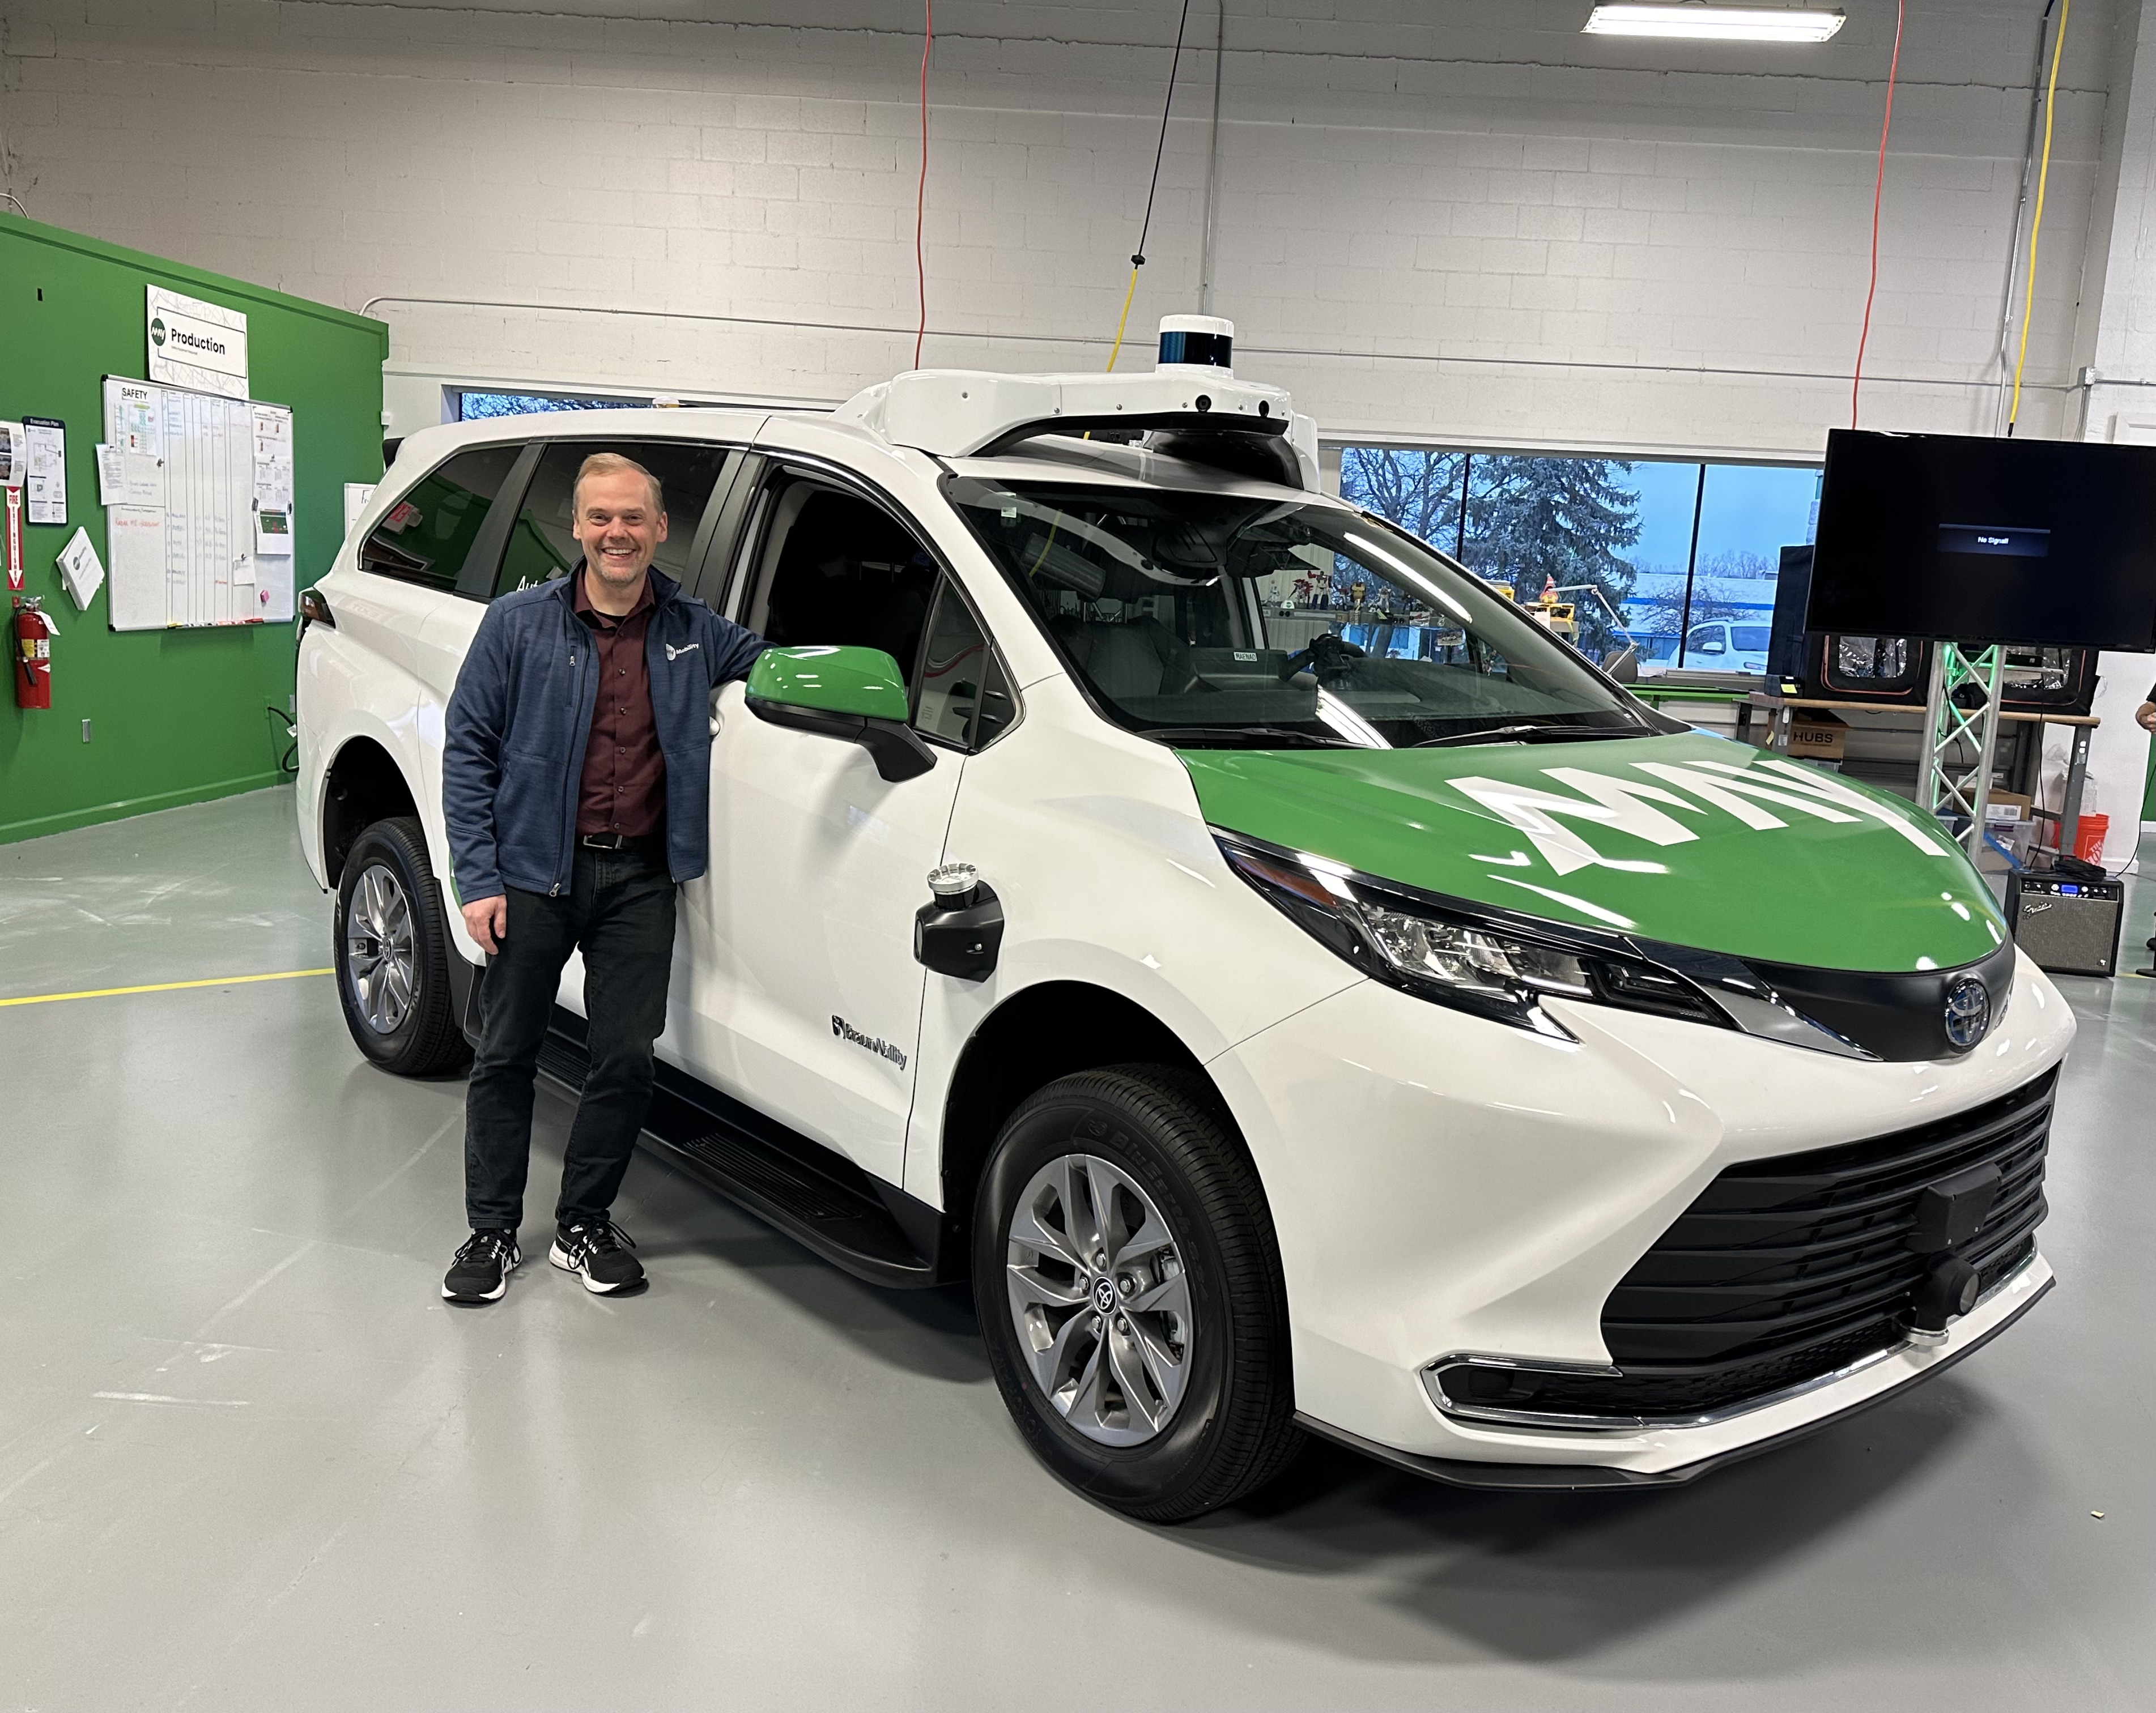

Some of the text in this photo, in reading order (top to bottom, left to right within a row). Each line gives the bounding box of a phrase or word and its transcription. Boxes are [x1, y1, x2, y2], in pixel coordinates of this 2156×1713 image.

[172, 328, 225, 355] Production
[122, 387, 147, 400] SAFETY
[9, 495, 19, 504] FIRE
[676, 644, 699, 655] Mobility
[1793, 732, 1834, 744] HUBS
[846, 1022, 907, 1071] BraunAbility
